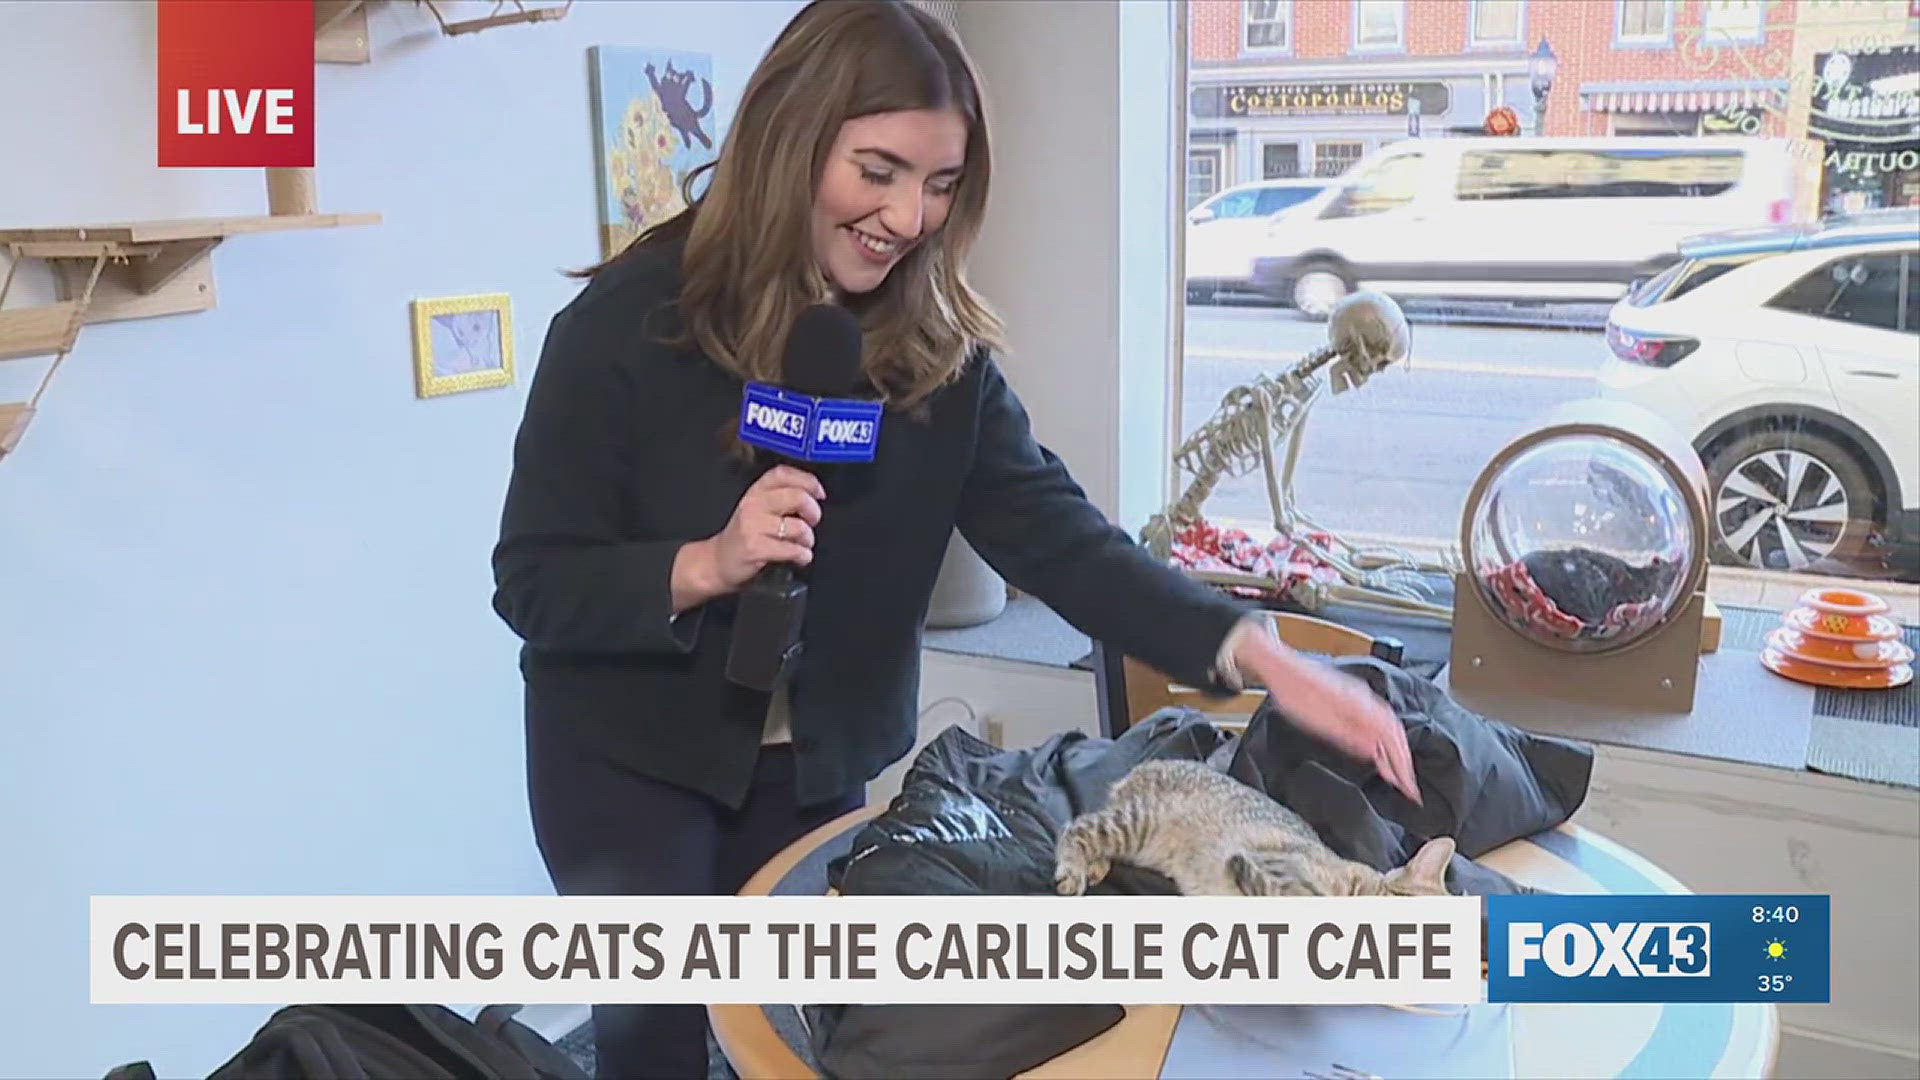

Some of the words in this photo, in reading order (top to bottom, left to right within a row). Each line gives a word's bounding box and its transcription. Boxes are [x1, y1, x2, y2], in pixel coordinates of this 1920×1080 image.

[1258, 85, 1310, 95] OFFICES
[1322, 85, 1338, 94] OF
[1230, 92, 1403, 112] COSTOPOULOS
[746, 402, 805, 438] FOX43
[817, 418, 873, 443] FOX43
